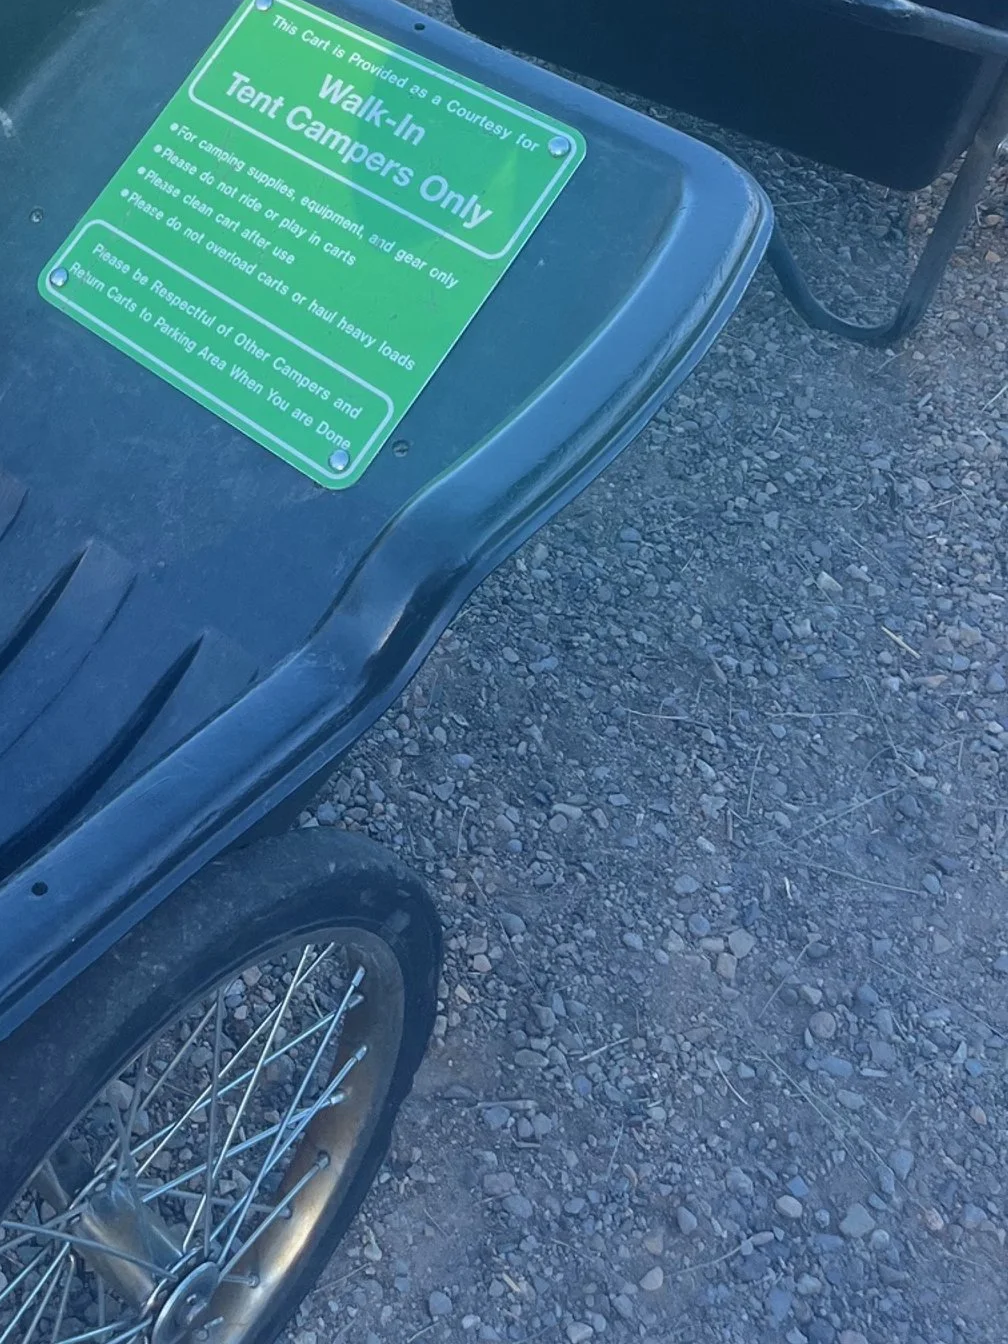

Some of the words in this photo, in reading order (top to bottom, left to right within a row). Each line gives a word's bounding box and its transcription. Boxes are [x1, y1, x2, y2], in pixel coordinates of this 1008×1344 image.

[225, 70, 285, 119] Tent
[284, 104, 413, 186] Campers
[419, 174, 493, 229] Only
[272, 14, 298, 36] This
[300, 28, 331, 51] Cart
[331, 43, 346, 59] is
[347, 51, 409, 88] Provided
[409, 84, 428, 98] as
[430, 94, 443, 106] a
[446, 99, 512, 140] Courtesy
[515, 133, 540, 152] for
[318, 73, 425, 145] Walk-In
[127, 191, 164, 221] Please
[165, 215, 183, 231] do
[182, 226, 205, 245] not
[205, 240, 258, 275] overload
[256, 271, 289, 296] carts
[290, 291, 307, 305] or
[307, 298, 338, 324] haul
[336, 315, 377, 348] heavy
[377, 340, 416, 371] loads
[143, 169, 181, 198] Please
[182, 194, 214, 217] clean
[214, 213, 241, 232] cart
[240, 228, 271, 250] after
[271, 245, 295, 265] use
[160, 146, 198, 176] Please
[198, 170, 215, 186] do
[216, 180, 238, 198] not
[237, 193, 263, 212] ride
[263, 208, 280, 221] or
[277, 217, 307, 239] play
[307, 230, 322, 246] in
[323, 242, 356, 266] carts
[176, 124, 198, 143] For
[198, 139, 246, 172] camping
[246, 166, 296, 202] supplies,
[300, 195, 364, 240] equipment,
[368, 233, 396, 253] and
[393, 248, 428, 270] gear
[428, 267, 459, 289] only
[69, 261, 105, 292] Return
[106, 285, 138, 313] Carts
[138, 306, 153, 323] to
[153, 315, 197, 353] Parking
[196, 345, 227, 371] Area
[229, 363, 264, 395] When
[266, 387, 290, 412] You
[290, 407, 314, 427] are
[315, 420, 351, 449] Done
[92, 242, 131, 274] Please
[131, 267, 149, 286] be
[150, 279, 217, 328] Respectful
[215, 323, 234, 338] of
[233, 332, 271, 362] Other
[272, 356, 331, 400] Campers
[332, 397, 363, 420] and
